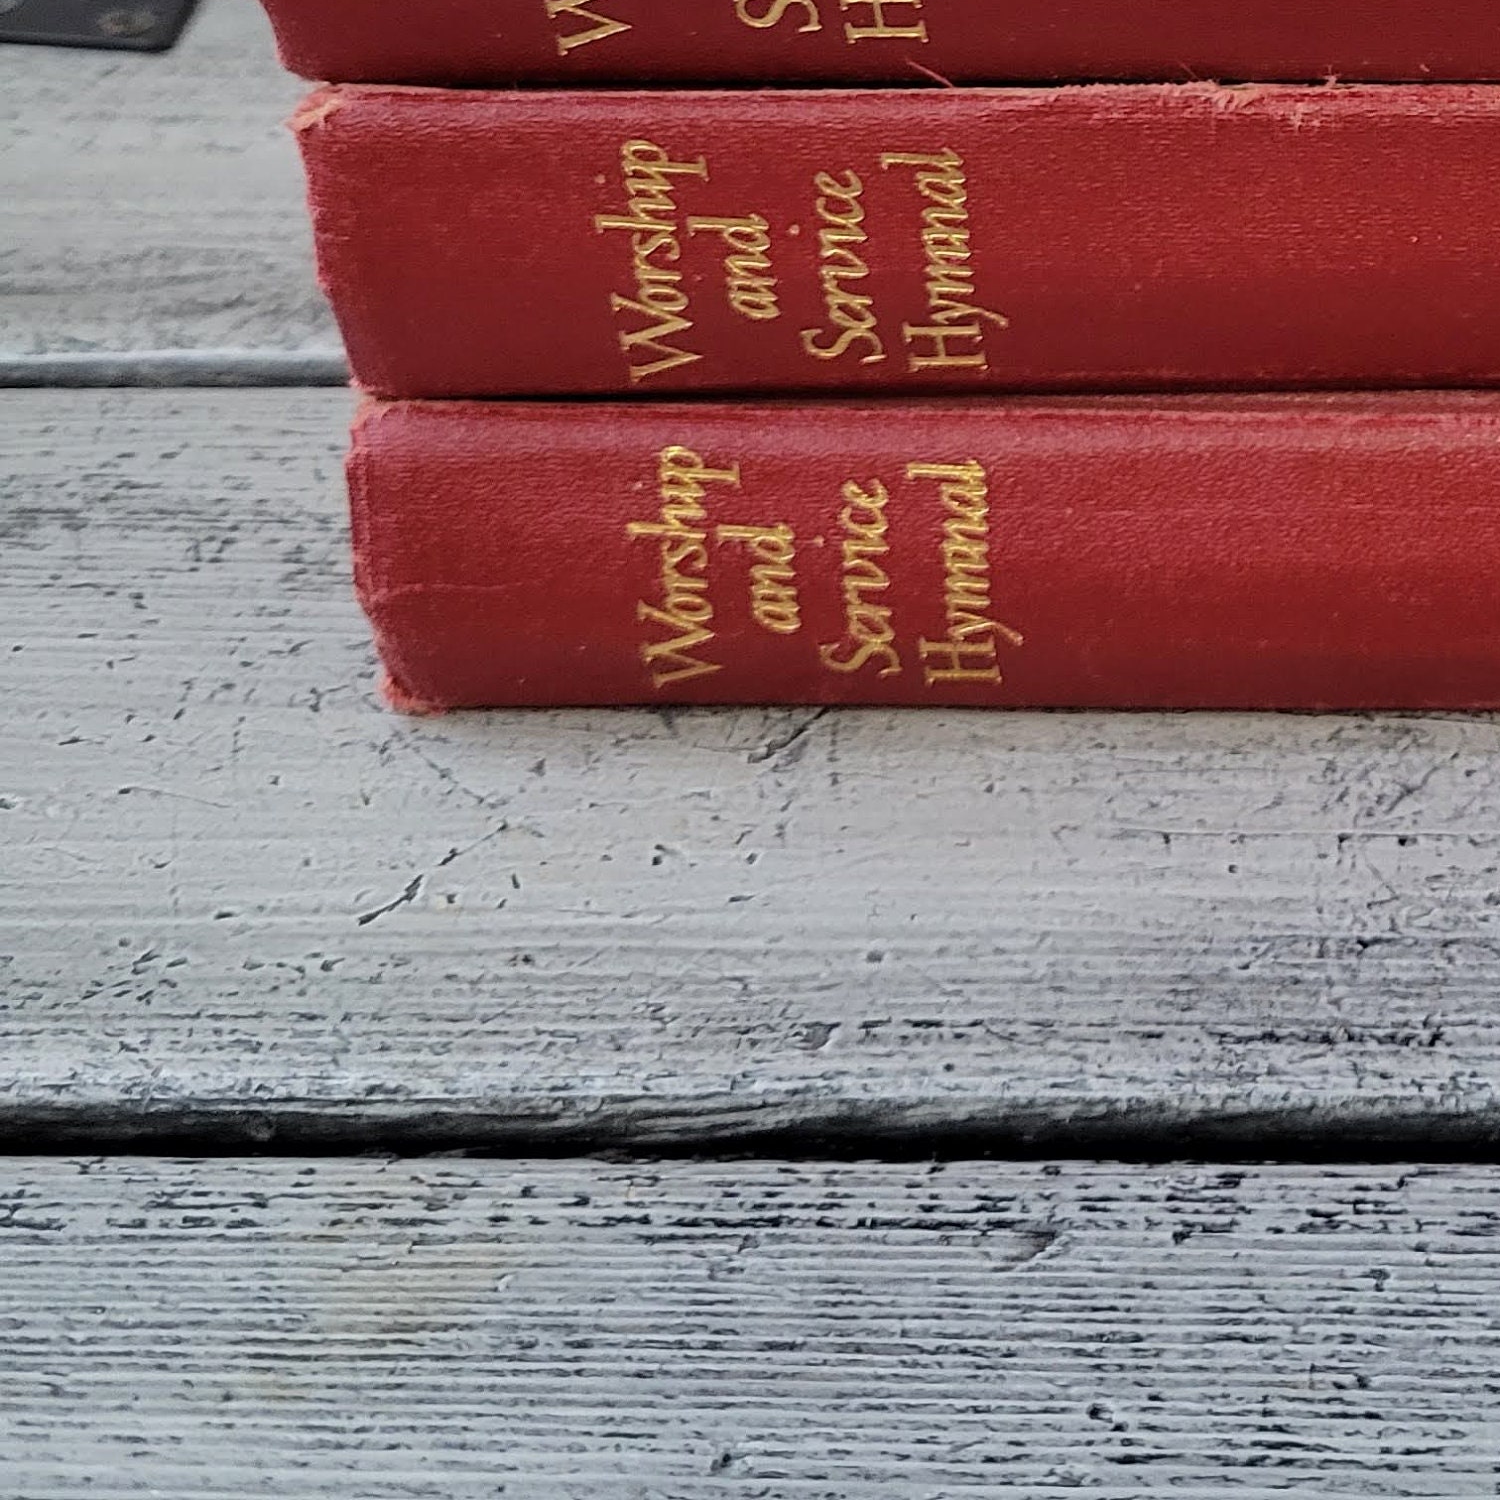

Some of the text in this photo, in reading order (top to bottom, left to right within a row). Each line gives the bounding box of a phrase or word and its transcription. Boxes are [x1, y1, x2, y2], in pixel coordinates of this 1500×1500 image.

[595, 139, 710, 382] Worship
[687, 213, 781, 320] and
[788, 169, 887, 364] Service
[881, 147, 1008, 373] Hymnal
[626, 445, 741, 689] Worship
[716, 523, 801, 633] and
[812, 478, 902, 678] Service
[906, 459, 1024, 687] Hymnal
